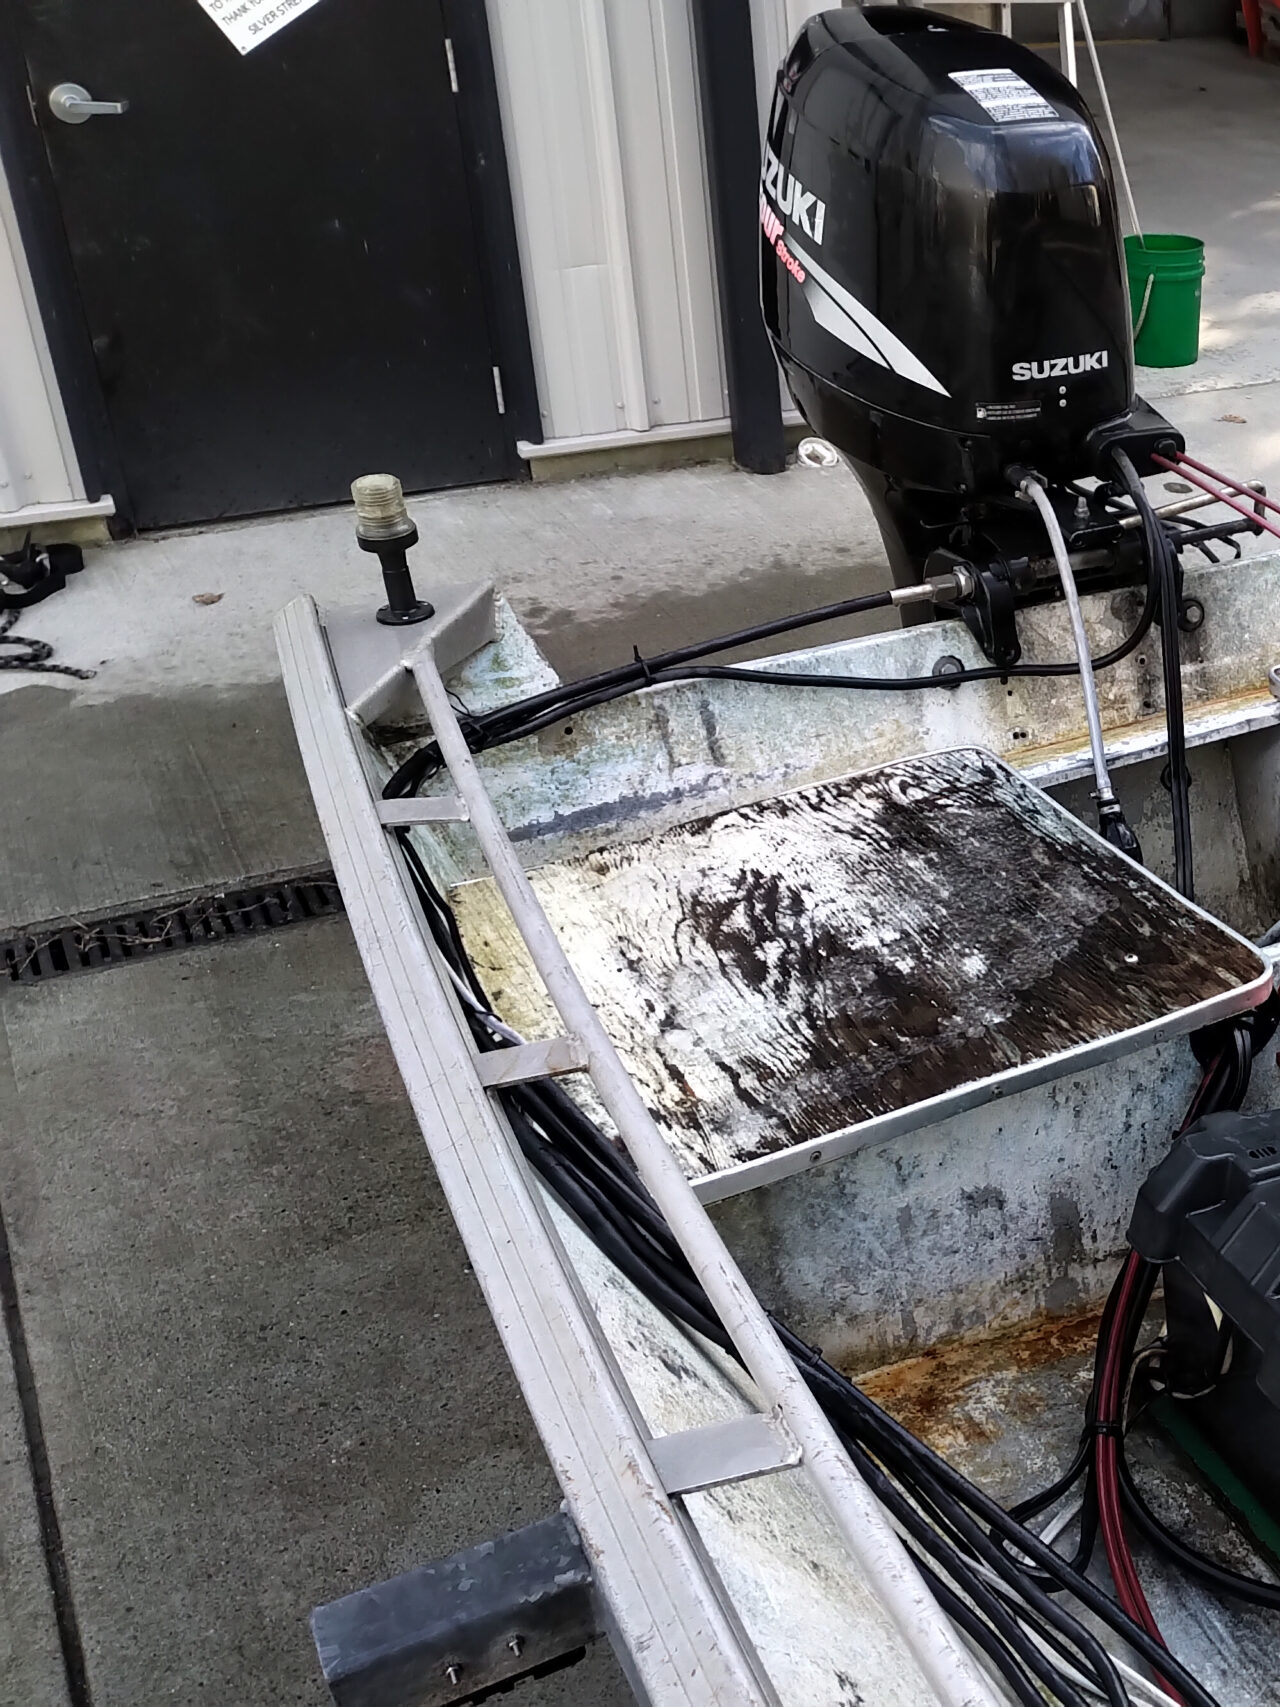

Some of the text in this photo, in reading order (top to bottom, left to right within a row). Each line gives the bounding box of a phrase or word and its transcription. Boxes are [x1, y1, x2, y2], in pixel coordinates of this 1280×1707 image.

[209, 0, 223, 12] TO
[222, 3, 250, 25] THANK
[248, 0, 304, 35] SILVER STRE
[761, 140, 826, 246] UZUKI
[1012, 350, 1109, 381] SUZUKI
